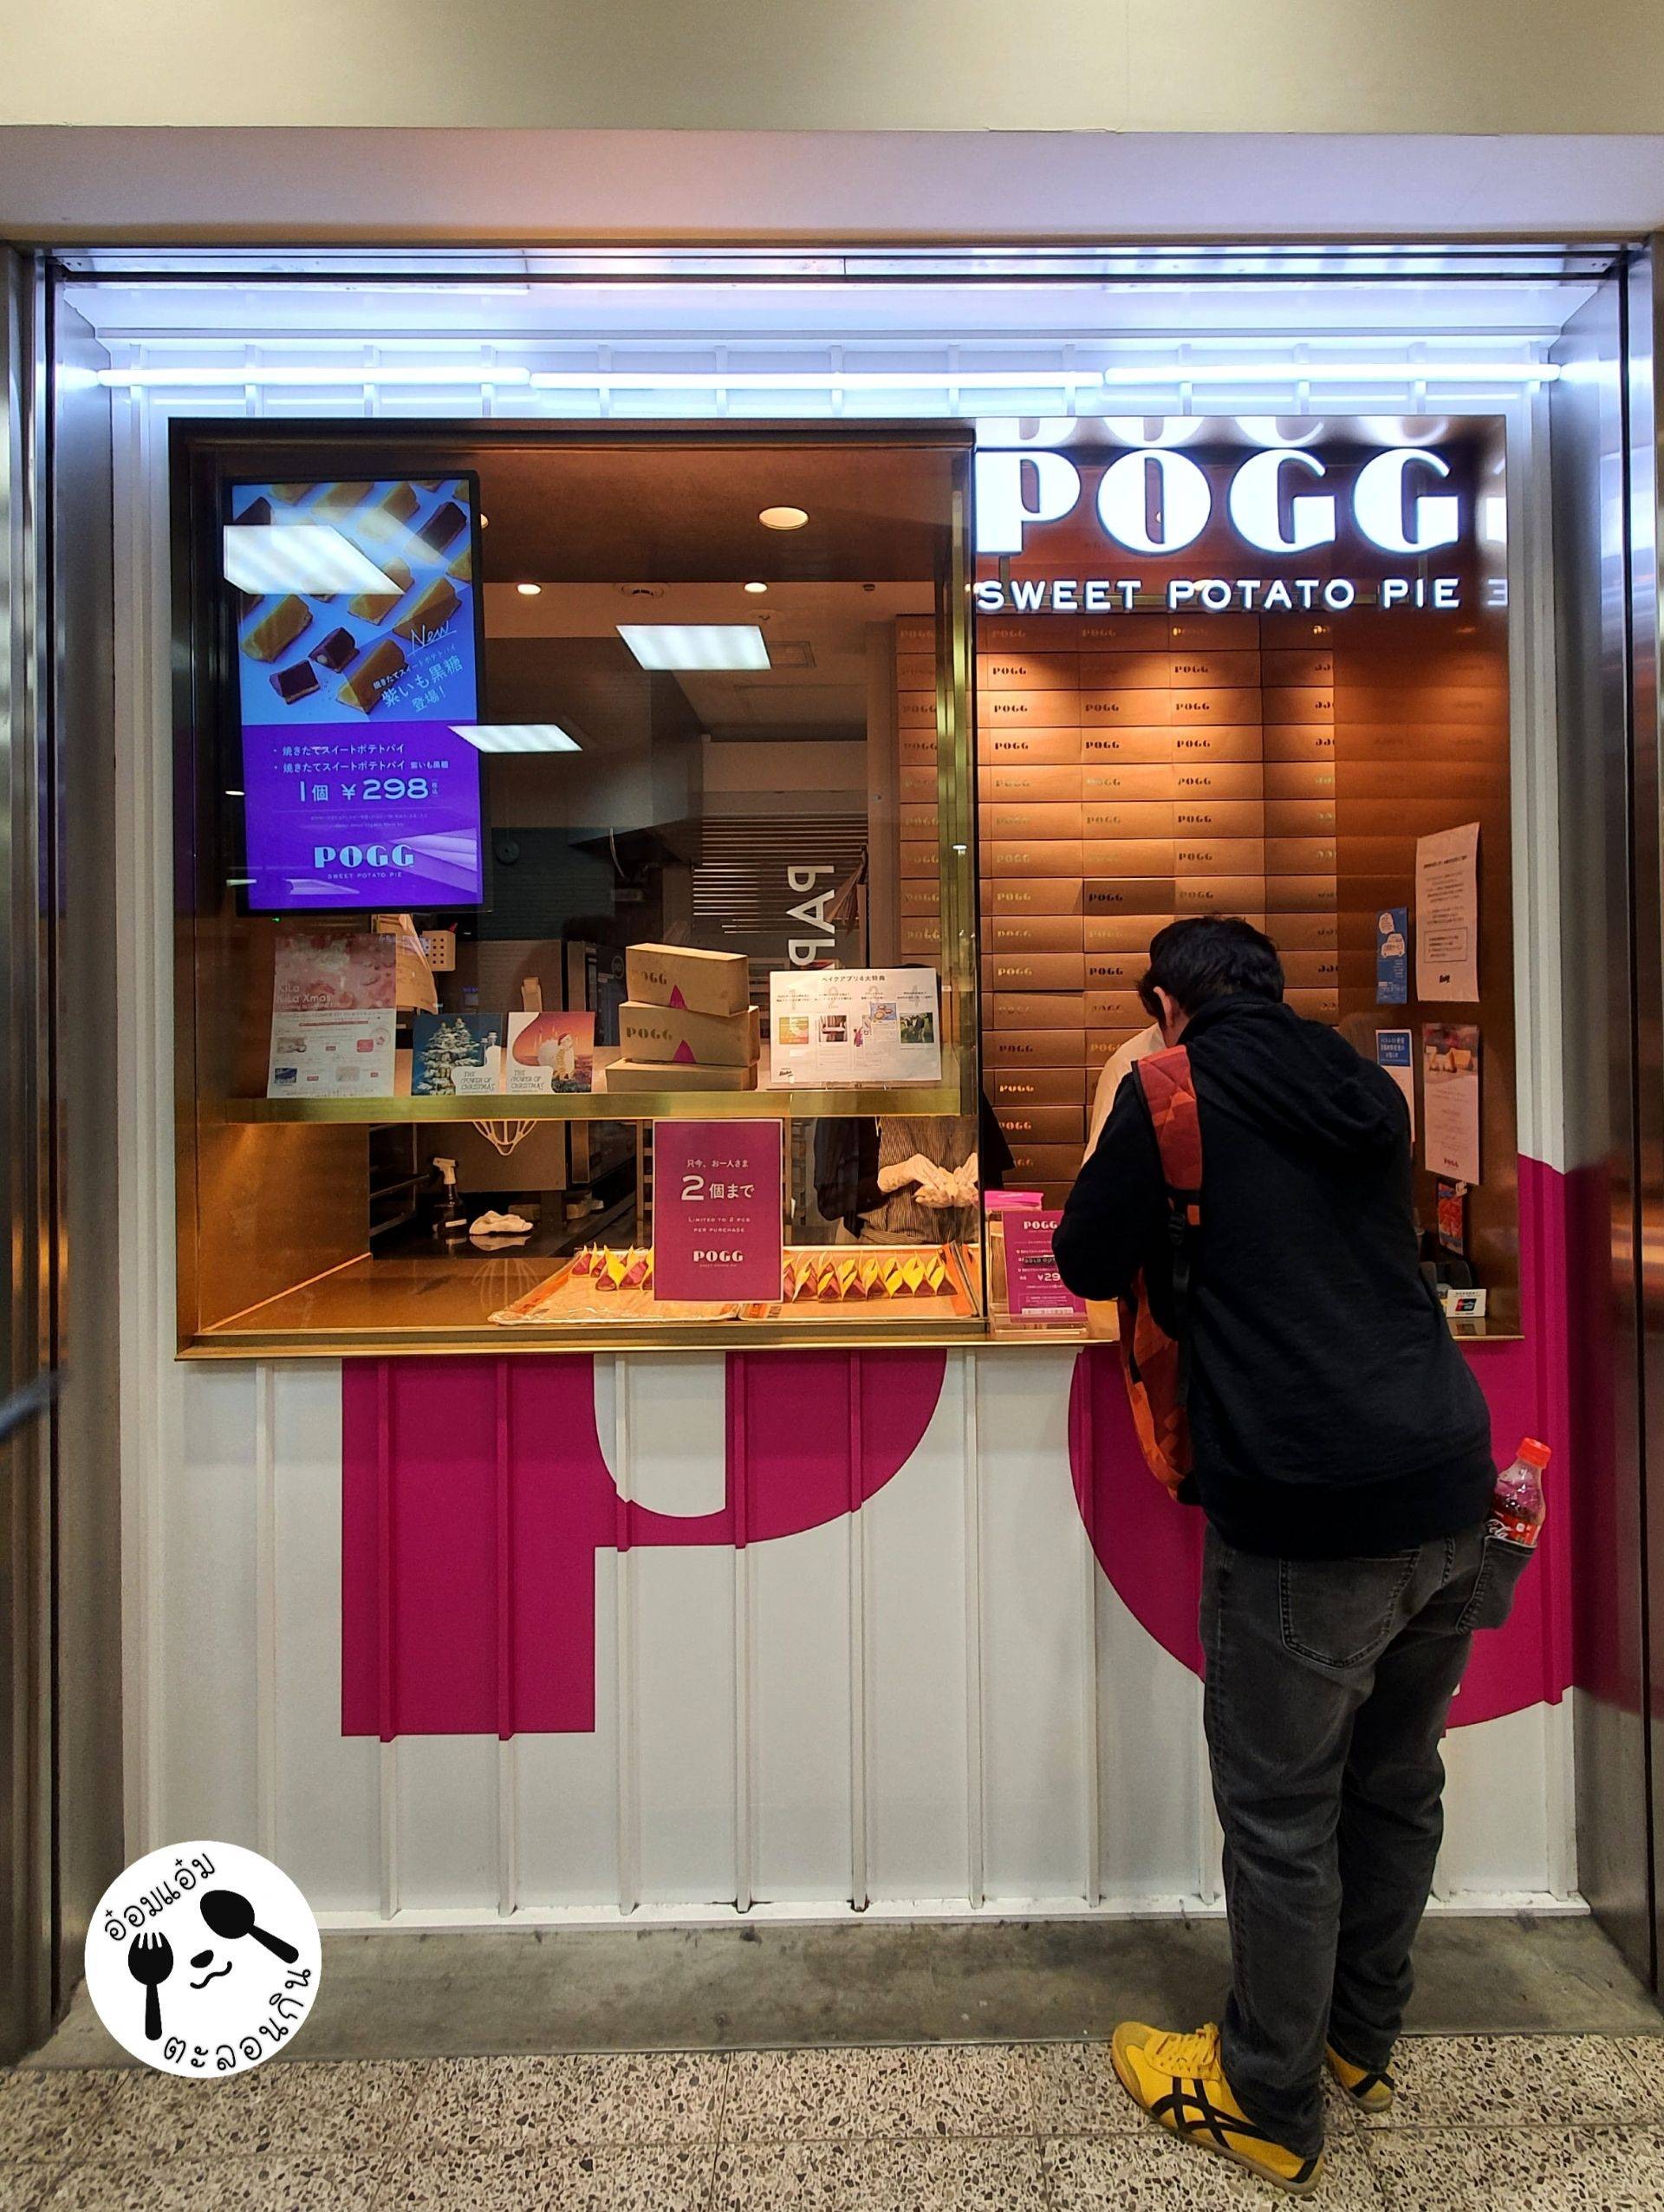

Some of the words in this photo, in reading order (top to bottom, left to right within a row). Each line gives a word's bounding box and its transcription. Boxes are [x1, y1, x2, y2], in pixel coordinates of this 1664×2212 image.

[974, 448, 1459, 554] POGG
[977, 579, 1143, 612] SWEET
[1168, 578, 1355, 610] POTATO
[1383, 578, 1460, 609] PIE
[410, 620, 452, 653] New
[992, 667, 1027, 675] POGG
[1174, 665, 1209, 673] POGG
[381, 654, 464, 707] 紫いも黒糖
[994, 704, 1028, 713] POGG
[1085, 703, 1120, 712] POGG
[1176, 702, 1210, 711] POGG
[994, 741, 1029, 751] POGG
[1085, 740, 1120, 750] POGG
[1177, 739, 1211, 748] POGG
[1178, 777, 1212, 786] POGG
[1086, 815, 1121, 824] POGG
[1178, 815, 1212, 823] POGG
[314, 844, 415, 869] POGG
[1179, 852, 1213, 861] POGG
[997, 892, 1031, 901] POGG
[1089, 893, 1124, 902] POGG
[998, 966, 1033, 977] POGG
[1089, 966, 1124, 976] POGG
[626, 1026, 673, 1041] POGG
[998, 1044, 1034, 1053] POGG
[999, 1084, 1035, 1093] POGG
[1023, 1220, 1058, 1230] POGG
[692, 1250, 744, 1263] POGG
